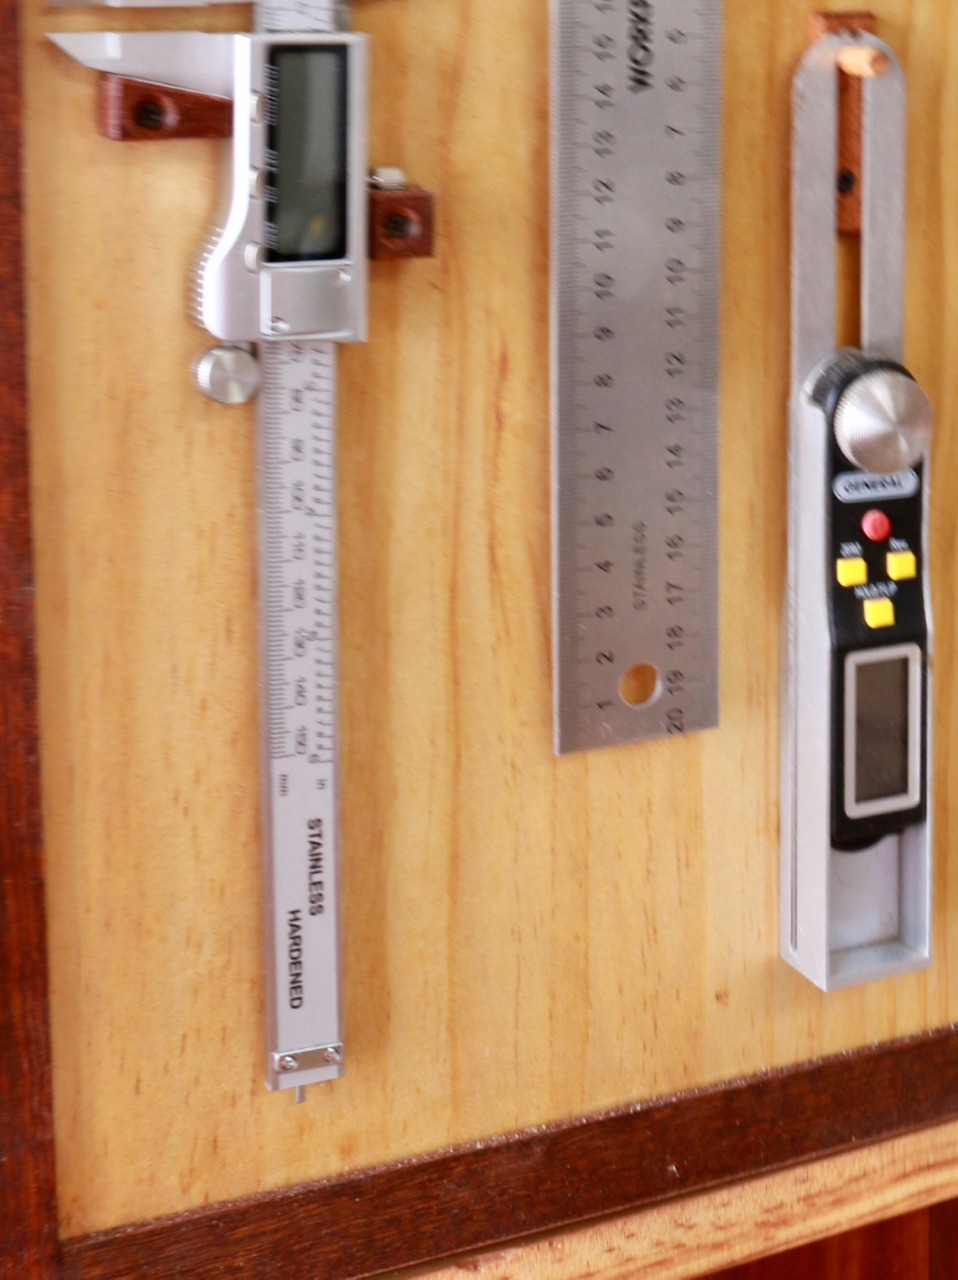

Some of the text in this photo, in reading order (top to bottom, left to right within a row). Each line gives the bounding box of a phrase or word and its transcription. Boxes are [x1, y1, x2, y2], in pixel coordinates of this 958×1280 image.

[593, 34, 615, 61] 15
[593, 82, 615, 110] 14
[593, 130, 615, 158] 13
[665, 125, 685, 138] 7
[665, 171, 685, 186] 8
[593, 179, 615, 206] 12
[665, 218, 685, 233] 9
[593, 229, 615, 252] 11
[665, 258, 685, 285] 10
[593, 274, 615, 300] 10
[665, 307, 685, 329] 11
[593, 327, 615, 341] 9
[665, 352, 685, 378] 12
[593, 374, 615, 387] 8
[665, 398, 685, 423] 13
[593, 422, 615, 434] 7
[666, 444, 684, 469] 14
[596, 467, 614, 481] 6
[666, 489, 684, 515] 15
[596, 514, 614, 527] 5
[666, 535, 684, 560] 16
[596, 559, 614, 574] 4
[632, 521, 647, 611] STAINLESS
[666, 582, 684, 605] 17
[596, 605, 614, 619] 3
[666, 625, 684, 650] 18
[596, 651, 614, 664] 2
[666, 670, 684, 695] 19
[596, 700, 614, 711] 1
[666, 708, 684, 734] 20
[307, 818, 324, 916] STAINLESS
[288, 909, 304, 1010] HARDENED
